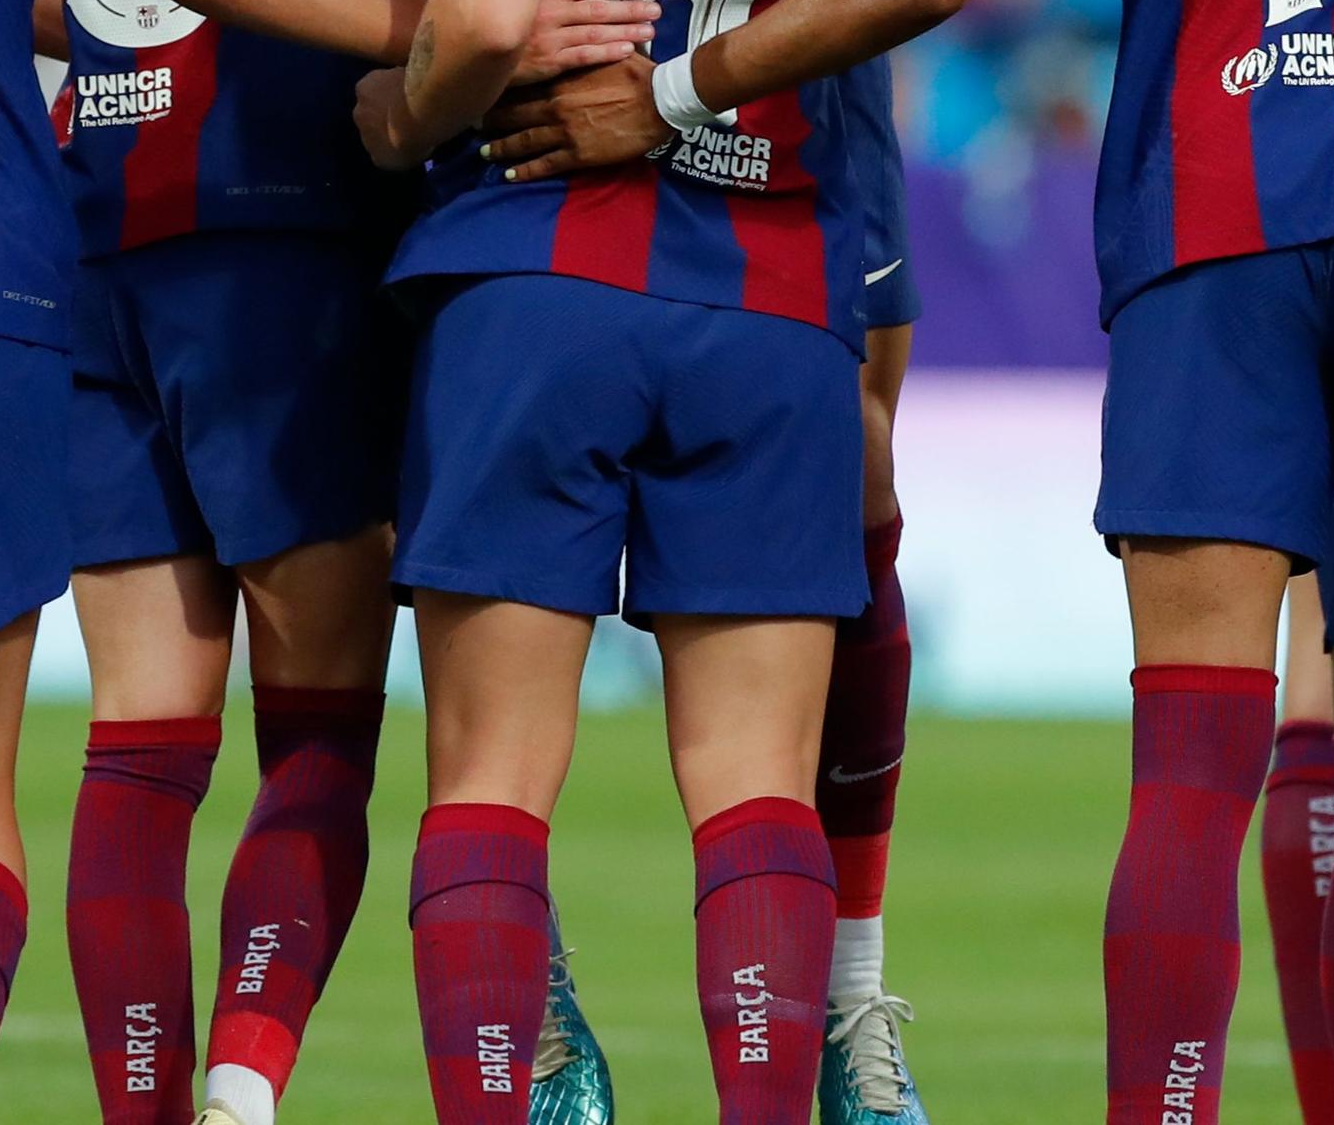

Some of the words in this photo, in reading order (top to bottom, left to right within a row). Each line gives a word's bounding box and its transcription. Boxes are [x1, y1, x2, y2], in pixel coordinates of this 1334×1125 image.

[77, 67, 172, 97] UNHCR
[1282, 76, 1298, 86] The
[1298, 77, 1310, 86] UN
[78, 88, 172, 118] ACNUR
[80, 119, 97, 127] The
[97, 118, 112, 127] UN
[112, 115, 145, 126] Refugee
[681, 125, 772, 160] UNHCR
[670, 161, 687, 174] The
[687, 167, 701, 178] UN
[700, 172, 735, 186] Refugee
[735, 179, 767, 191] Agency
[672, 143, 769, 182] ACNUR
[236, 923, 281, 994] BARÇA
[732, 963, 774, 1063] BARÇA
[125, 1002, 162, 1092] BARÇA
[477, 1024, 515, 1093] BARÇA
[1162, 1041, 1207, 1125] BARÇA
